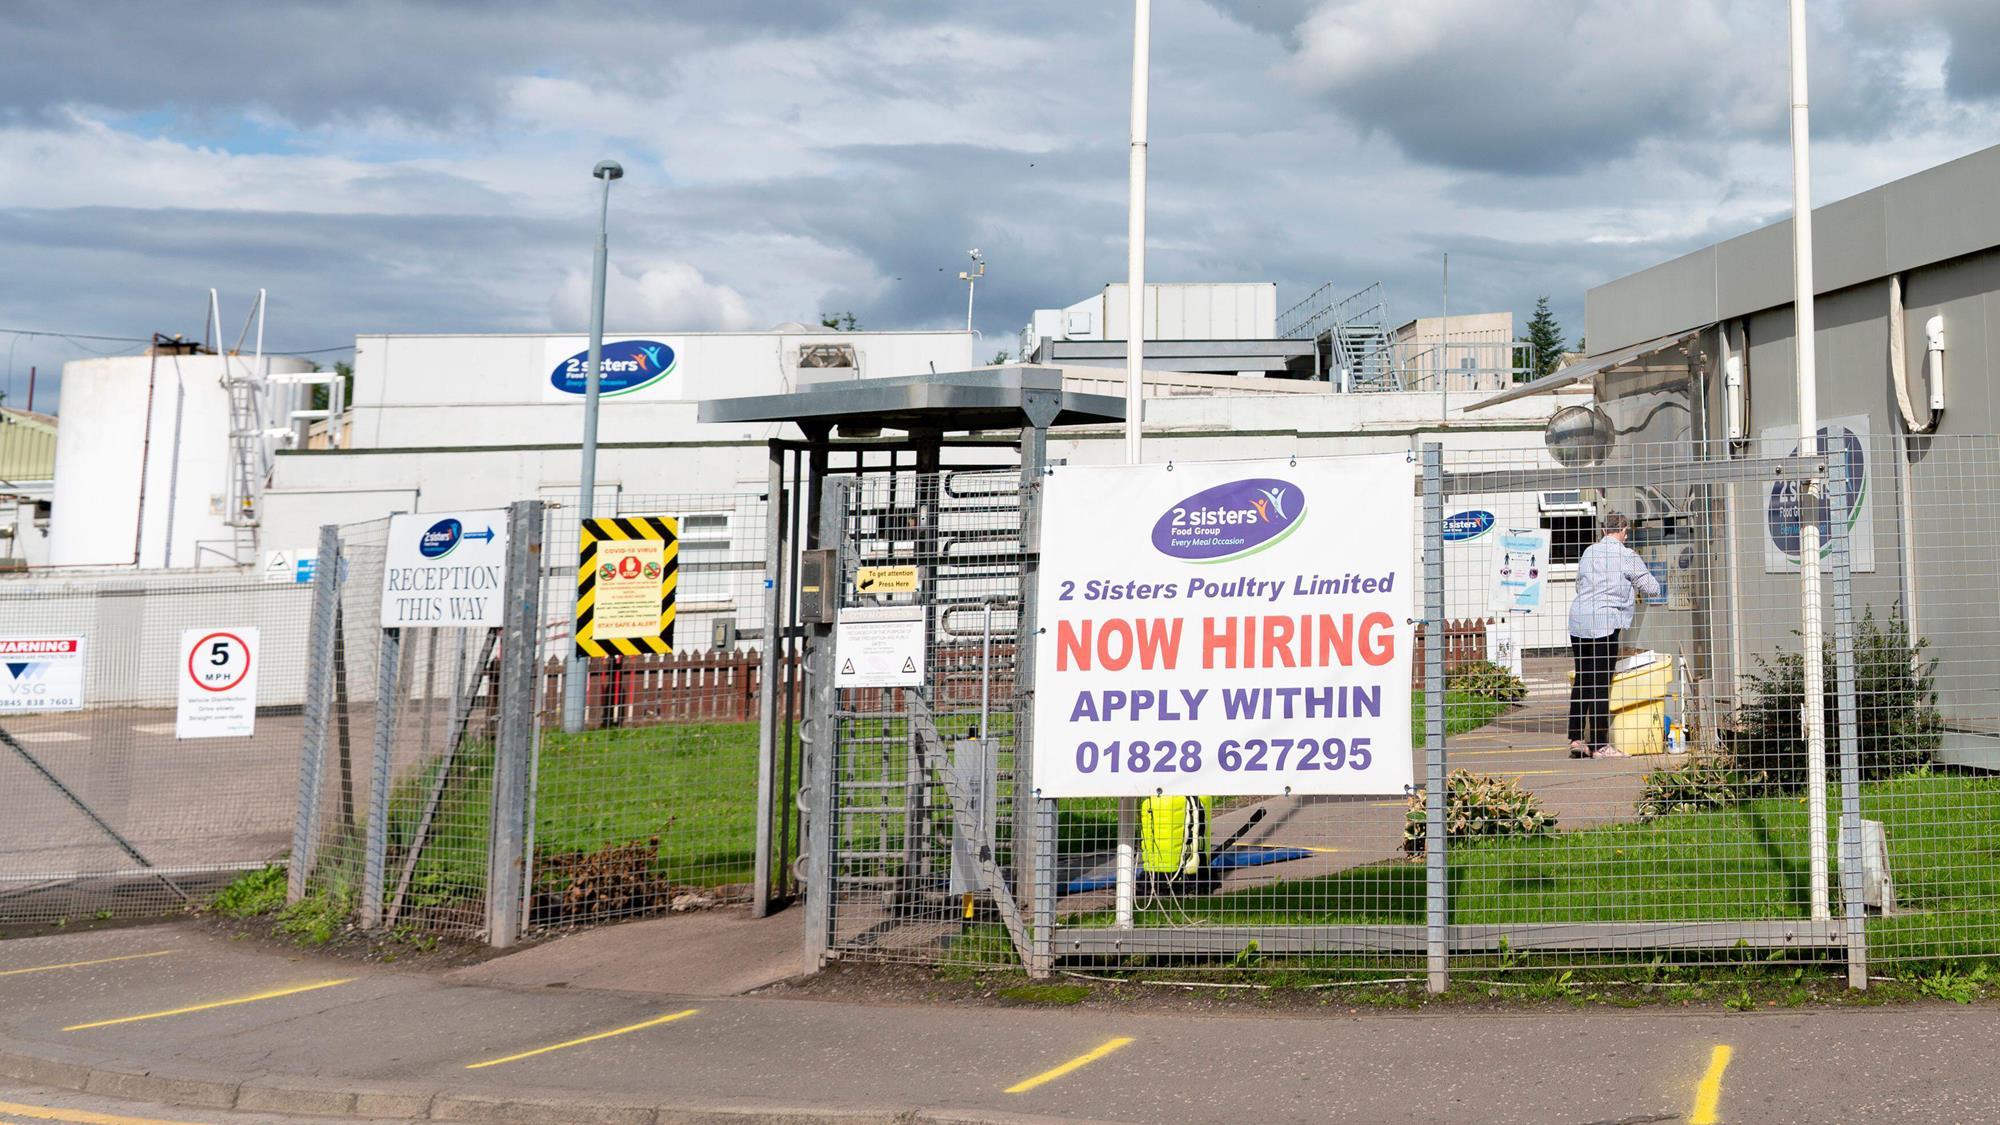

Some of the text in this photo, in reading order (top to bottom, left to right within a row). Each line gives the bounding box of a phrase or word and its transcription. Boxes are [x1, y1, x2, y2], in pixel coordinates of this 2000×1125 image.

[566, 358, 580, 372] 2
[1172, 507, 1257, 526] 2 sisters
[1449, 520, 1477, 529] sisters
[1171, 527, 1221, 537] Food Group
[1171, 537, 1244, 548] Every Meal Occasion
[389, 566, 500, 591] RECEPTION
[1058, 572, 1395, 602] 2 Sisters Poultry Limited
[396, 597, 487, 621] THIS WAY
[1056, 611, 1395, 672] NOW HIRING
[210, 642, 229, 666] 5
[8, 683, 46, 695] VSG
[49, 698, 73, 706] 7601
[1069, 685, 1381, 722] APPLY WITHIN
[1076, 737, 1372, 774] 01828 627295
